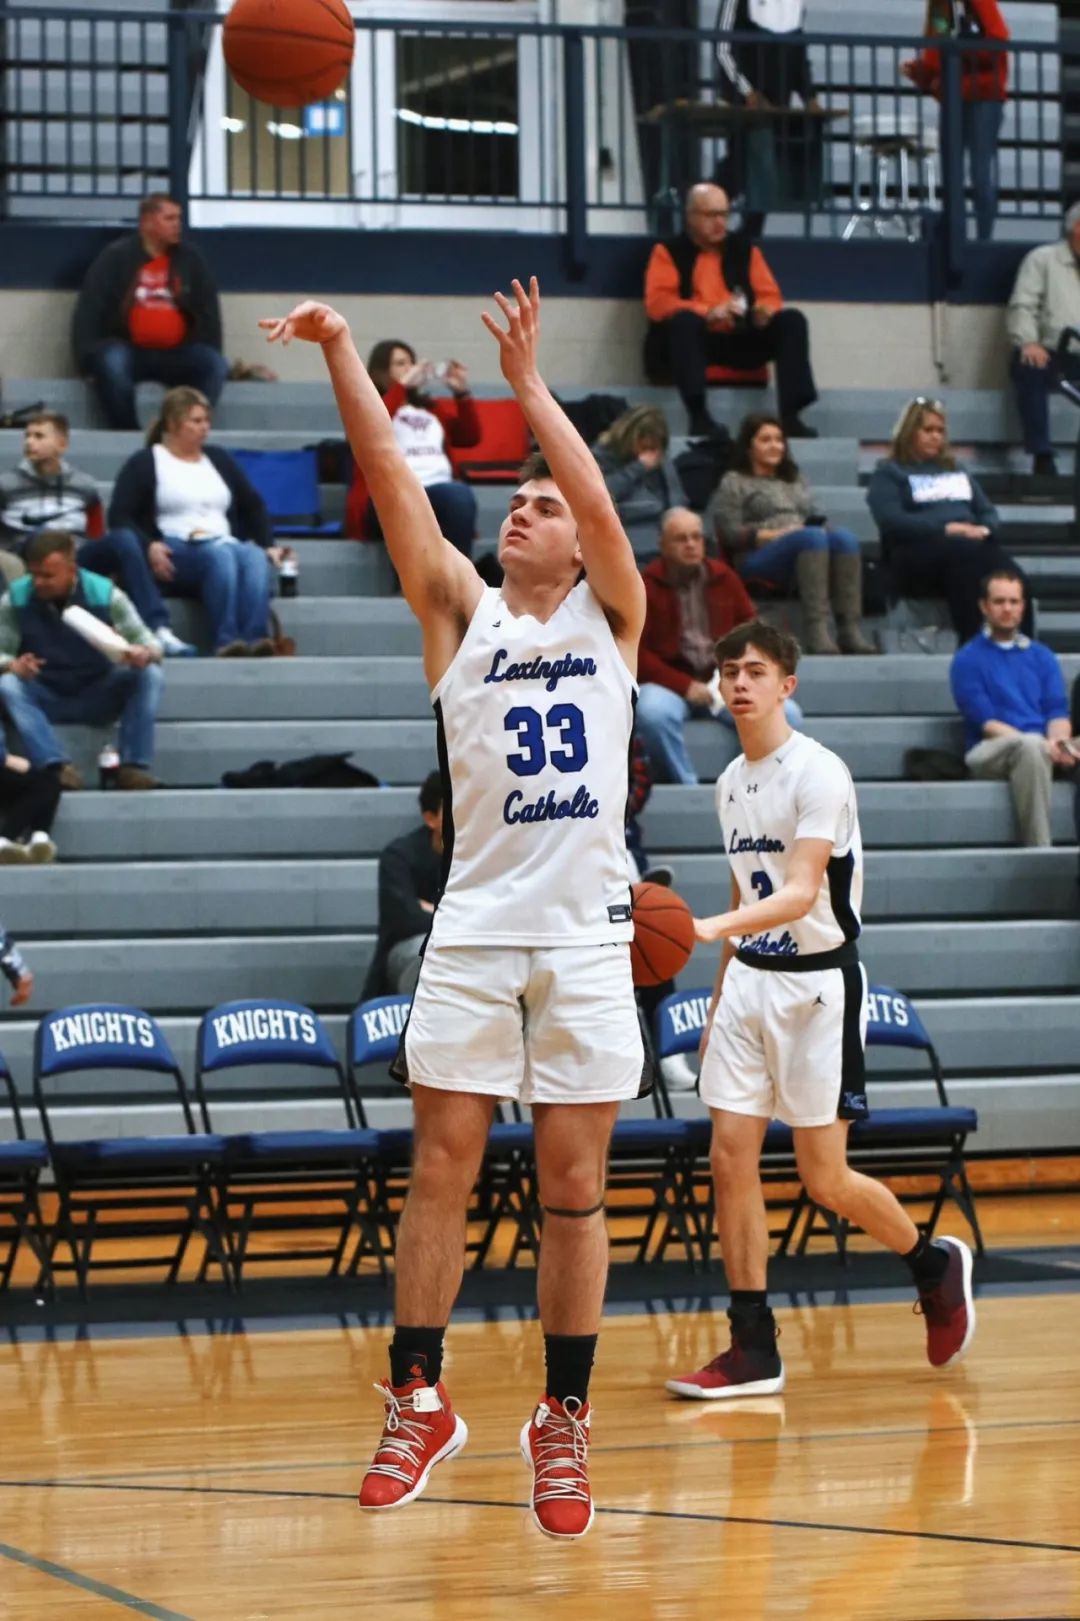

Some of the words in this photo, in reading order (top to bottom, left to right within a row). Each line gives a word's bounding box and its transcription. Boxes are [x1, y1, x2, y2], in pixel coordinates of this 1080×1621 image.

[484, 649, 597, 692] Lexington
[504, 703, 589, 777] 33
[503, 785, 599, 825] Catholic
[212, 1007, 317, 1048] KNIGHTS
[668, 996, 712, 1035] KNI
[866, 993, 909, 1027] HTS
[49, 1012, 155, 1052] KNIGHTS
